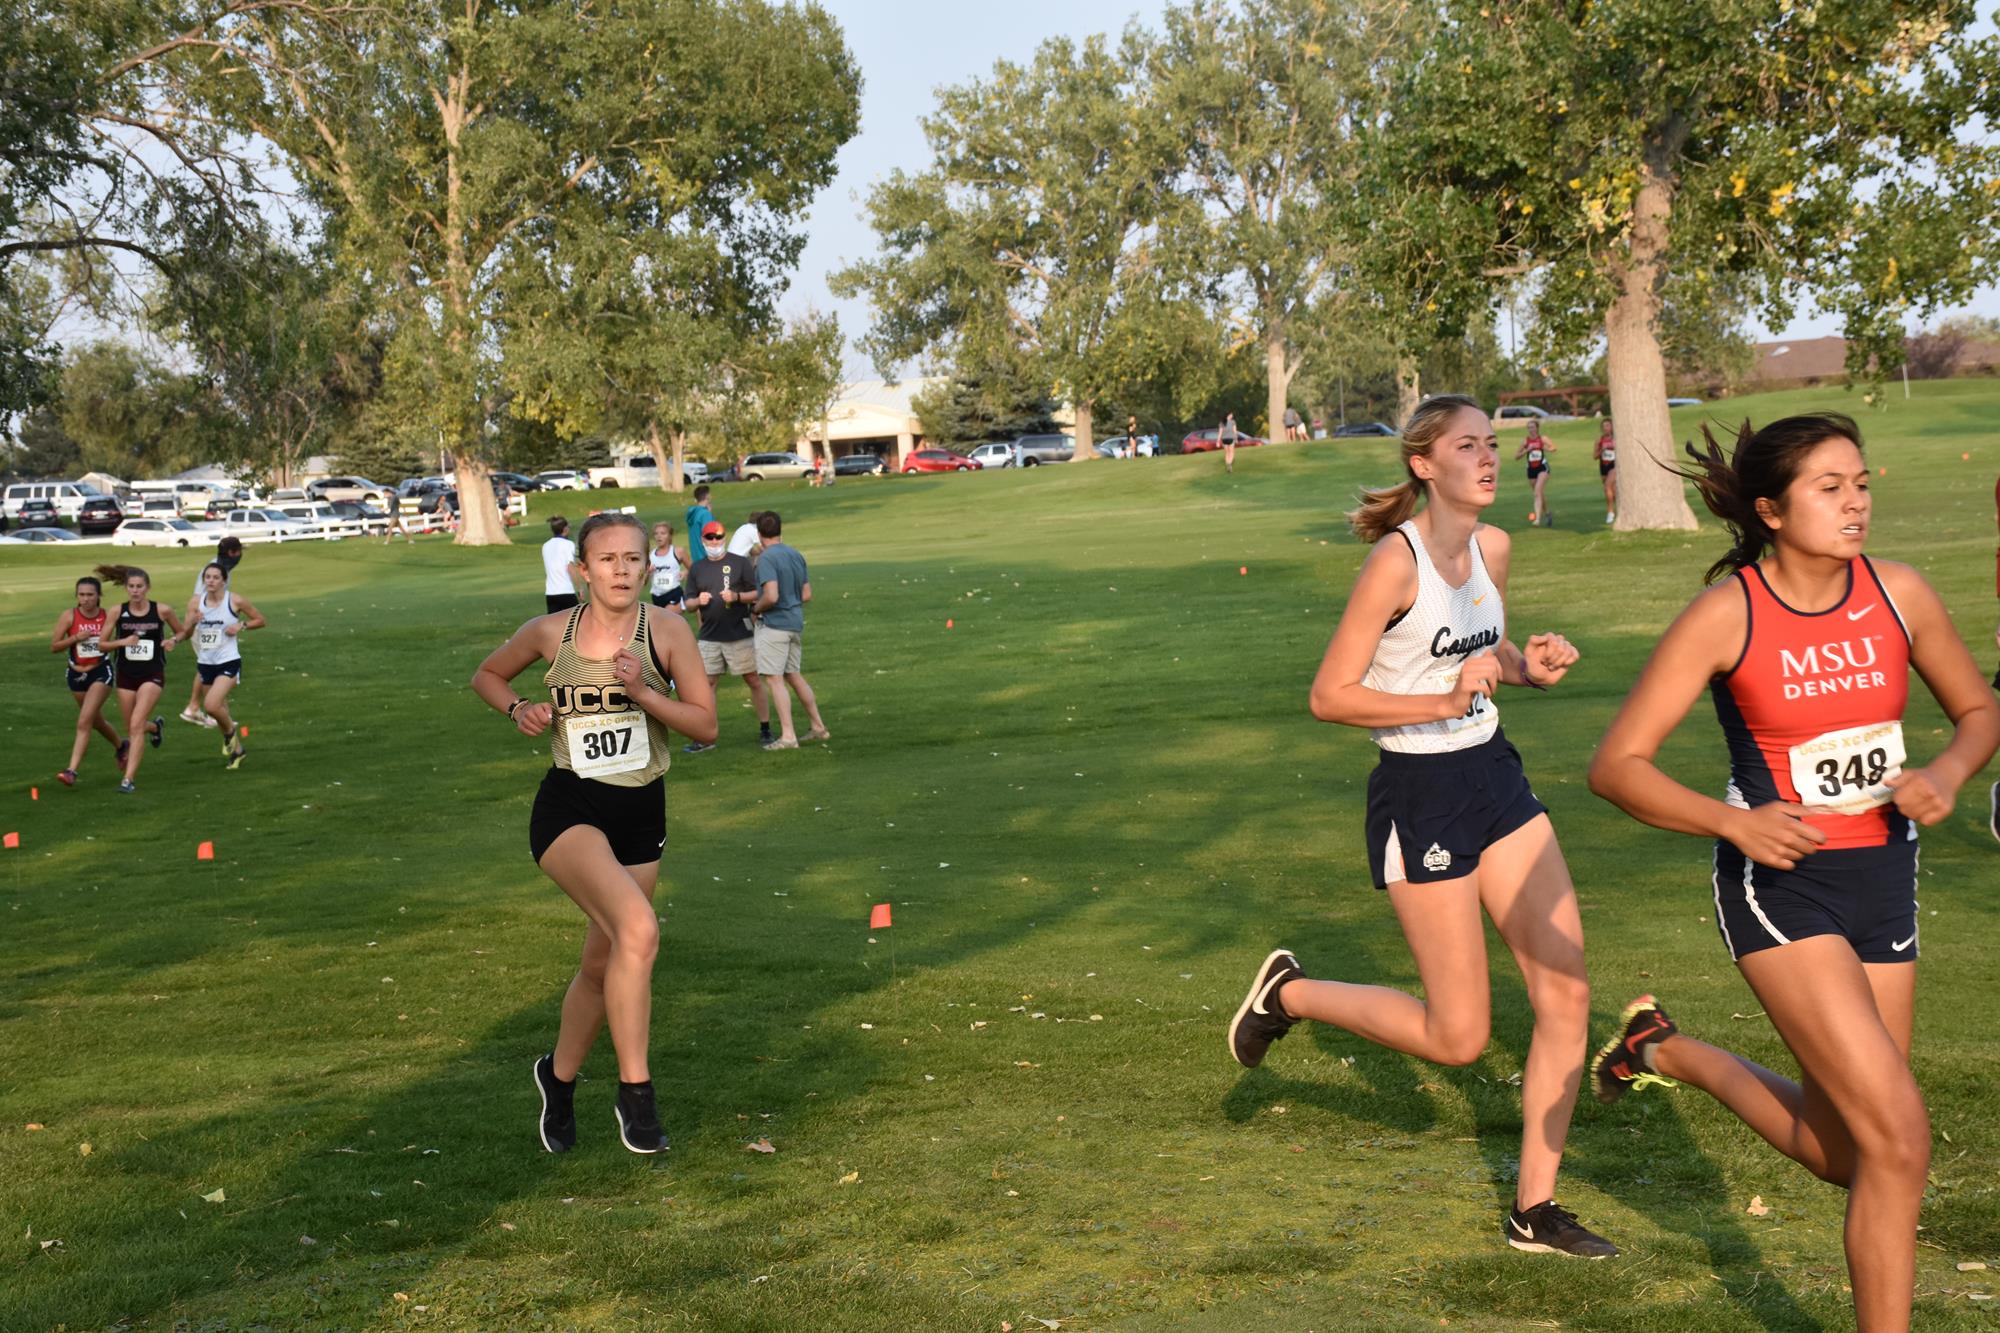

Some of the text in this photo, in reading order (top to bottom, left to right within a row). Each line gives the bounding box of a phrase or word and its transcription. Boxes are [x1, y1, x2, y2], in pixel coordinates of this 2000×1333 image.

[130, 645, 148, 655] 324
[201, 634, 217, 643] 327
[1430, 626, 1499, 663] Cougars
[1778, 636, 1877, 678] MSU
[550, 685, 641, 715] UCC
[1783, 671, 1887, 700] DENVER
[572, 714, 640, 730] UCCS XC OPEN
[583, 727, 632, 760] 307
[1800, 725, 1894, 756] UCCS XC OPEN
[1815, 747, 1888, 797] 348
